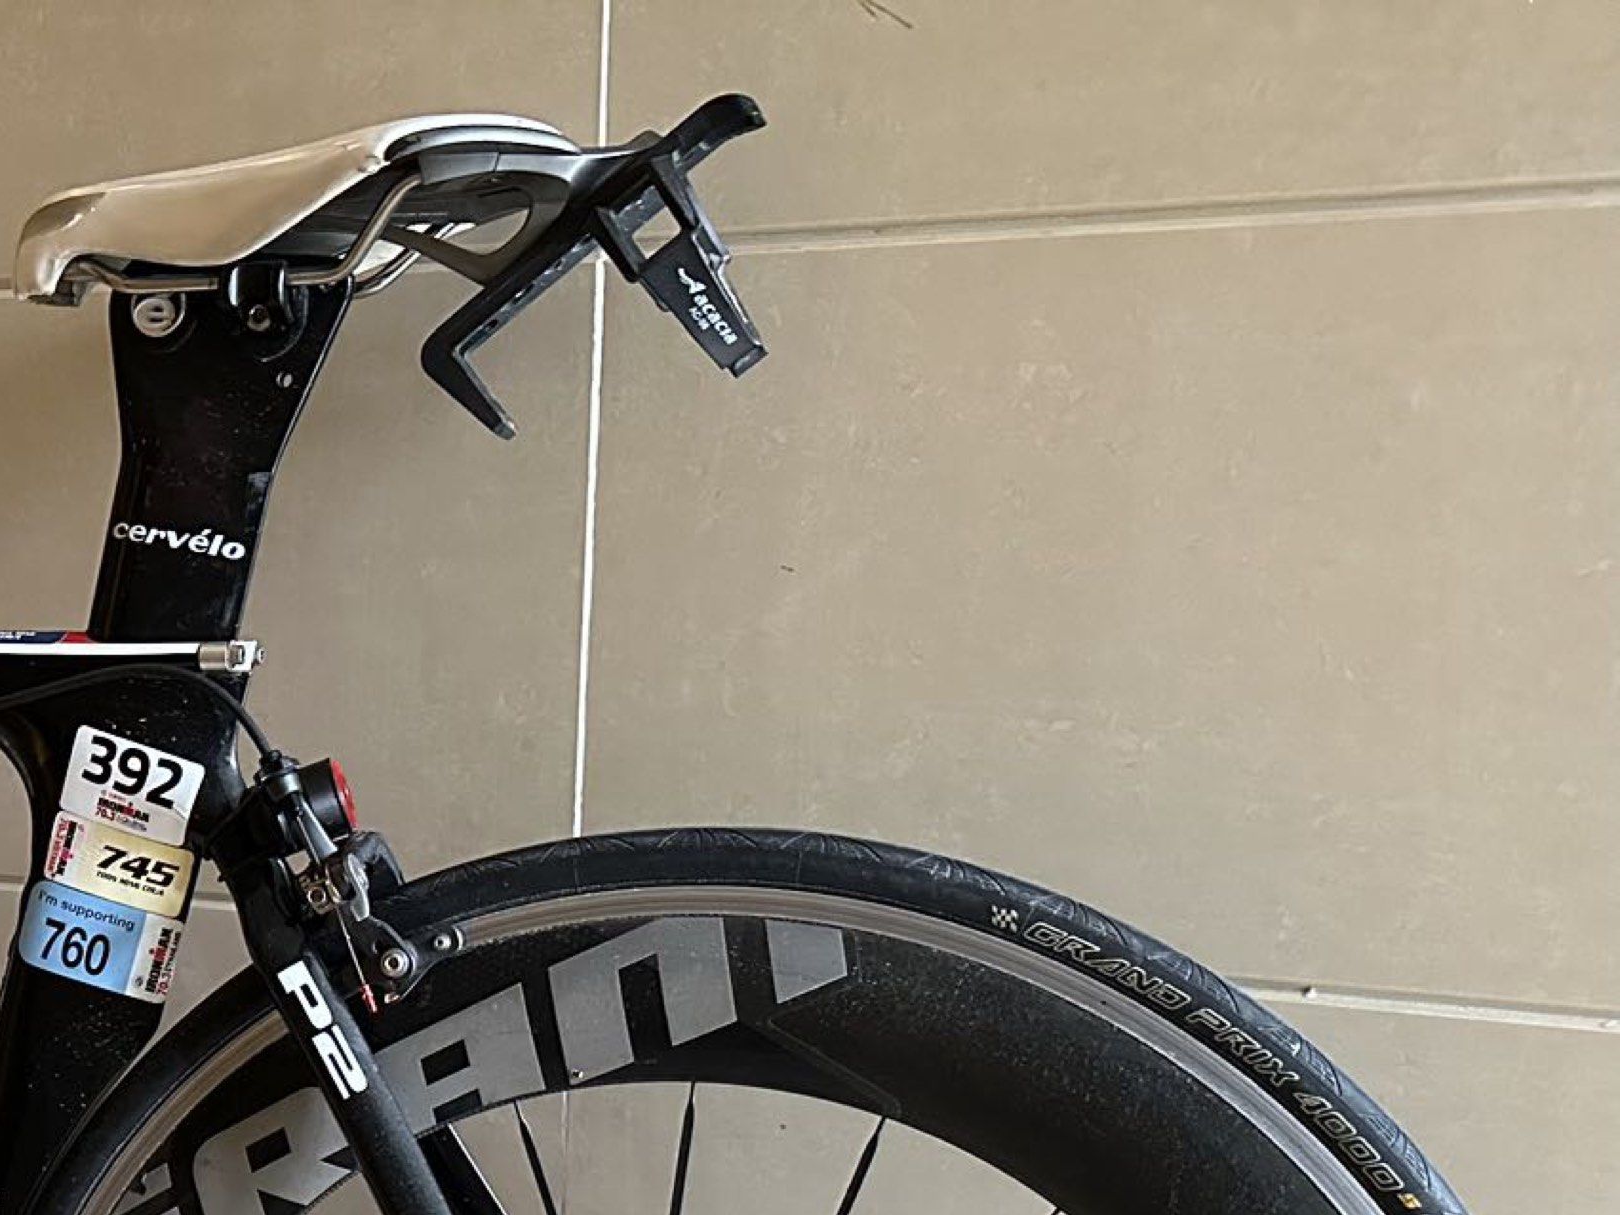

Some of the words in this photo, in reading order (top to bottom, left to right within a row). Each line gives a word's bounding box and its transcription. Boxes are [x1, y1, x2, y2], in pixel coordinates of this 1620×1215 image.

[114, 522, 246, 559] cervélo
[82, 734, 183, 810] 392
[97, 845, 180, 888] 745
[61, 900, 135, 932] supporting
[40, 917, 111, 976] 760
[277, 961, 367, 1099] P2
[1024, 922, 1192, 1012] GRAND
[1187, 1008, 1300, 1088] PRIX
[1293, 1089, 1404, 1192] 4000
